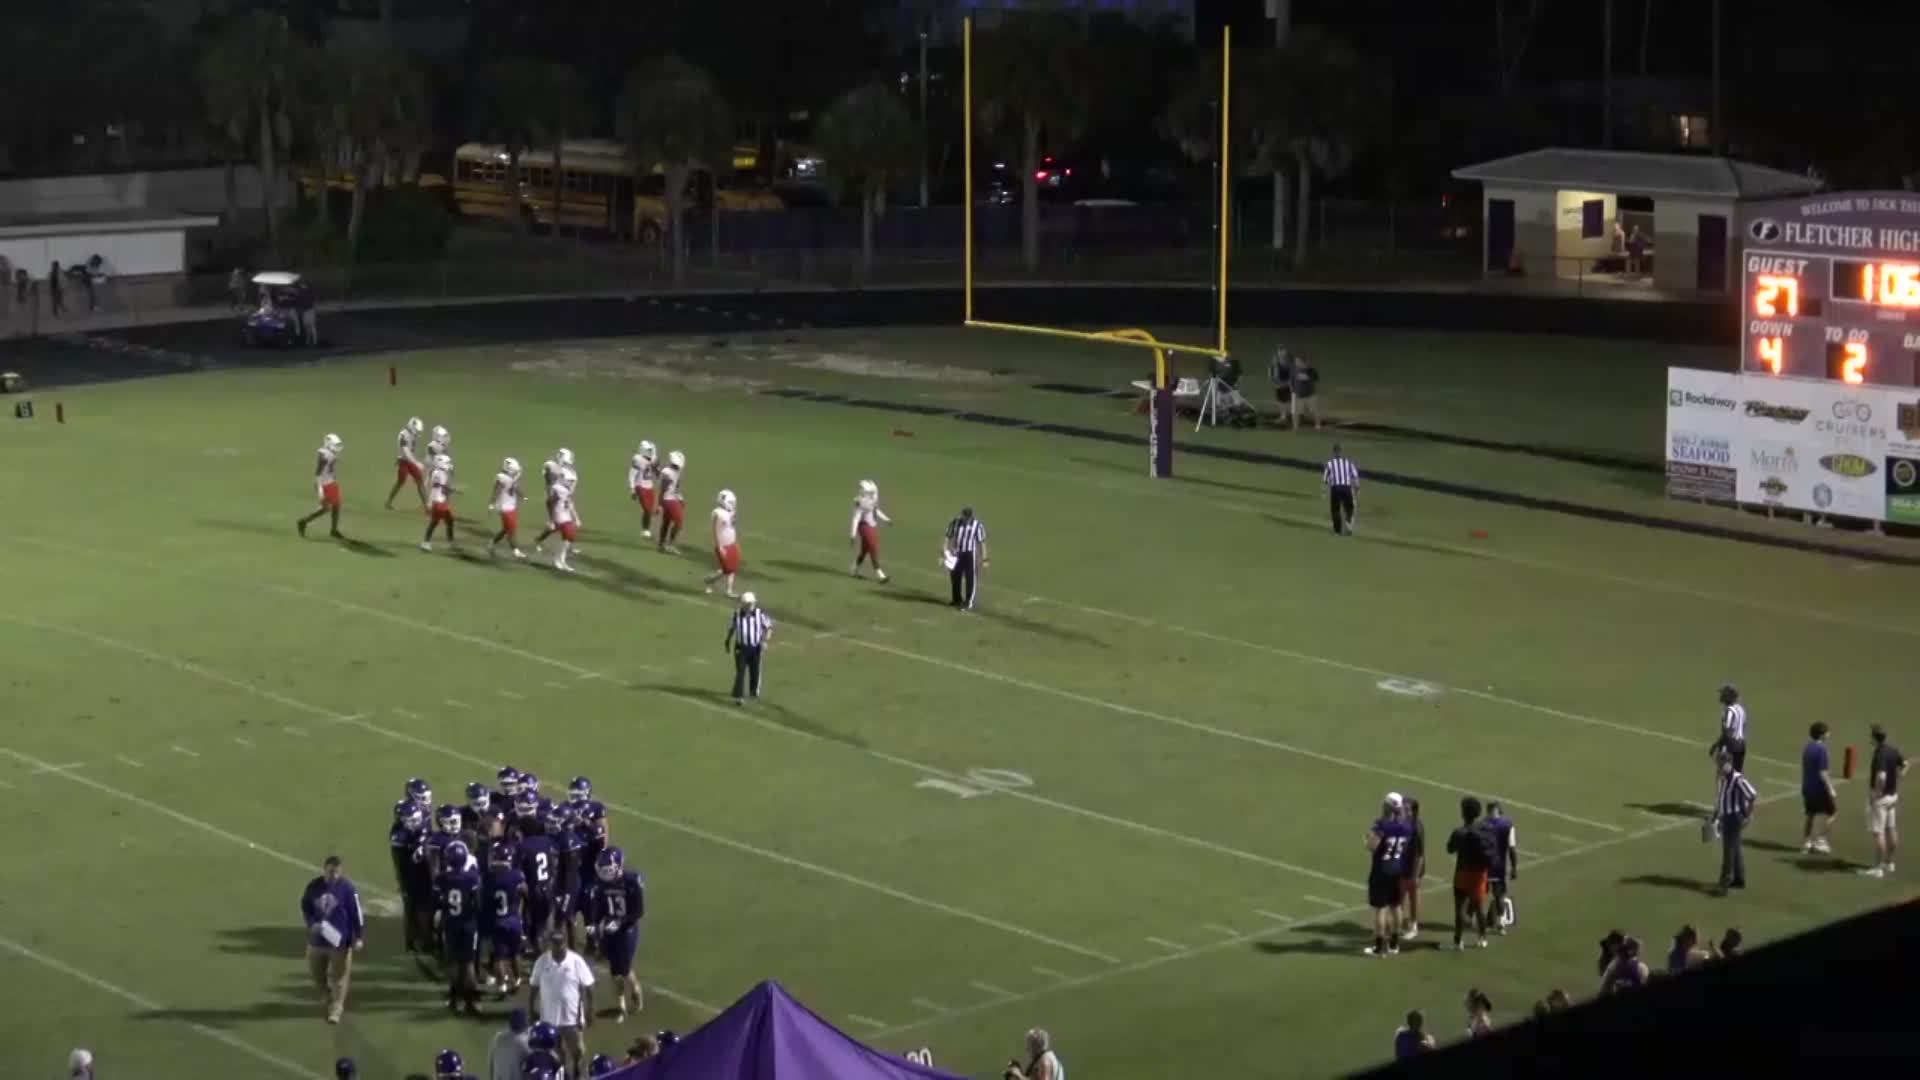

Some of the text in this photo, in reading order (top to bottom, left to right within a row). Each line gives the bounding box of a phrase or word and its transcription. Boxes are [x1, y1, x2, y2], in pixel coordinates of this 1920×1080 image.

[1784, 222, 1873, 249] FLETCHER
[1748, 256, 1808, 275] GUEST
[1756, 275, 1798, 317] 27
[1750, 320, 1793, 336] DOWN
[1824, 326, 1843, 343] TO
[1760, 337, 1782, 377] 4
[1843, 343, 1867, 385] 2
[1685, 391, 1737, 412] Rockaway
[1815, 420, 1887, 440] CRUISERS
[1672, 447, 1730, 462] SEAFOOD
[535, 852, 549, 881] 2
[448, 889, 462, 916] 9
[495, 890, 509, 916] 3
[607, 895, 627, 917] 13
